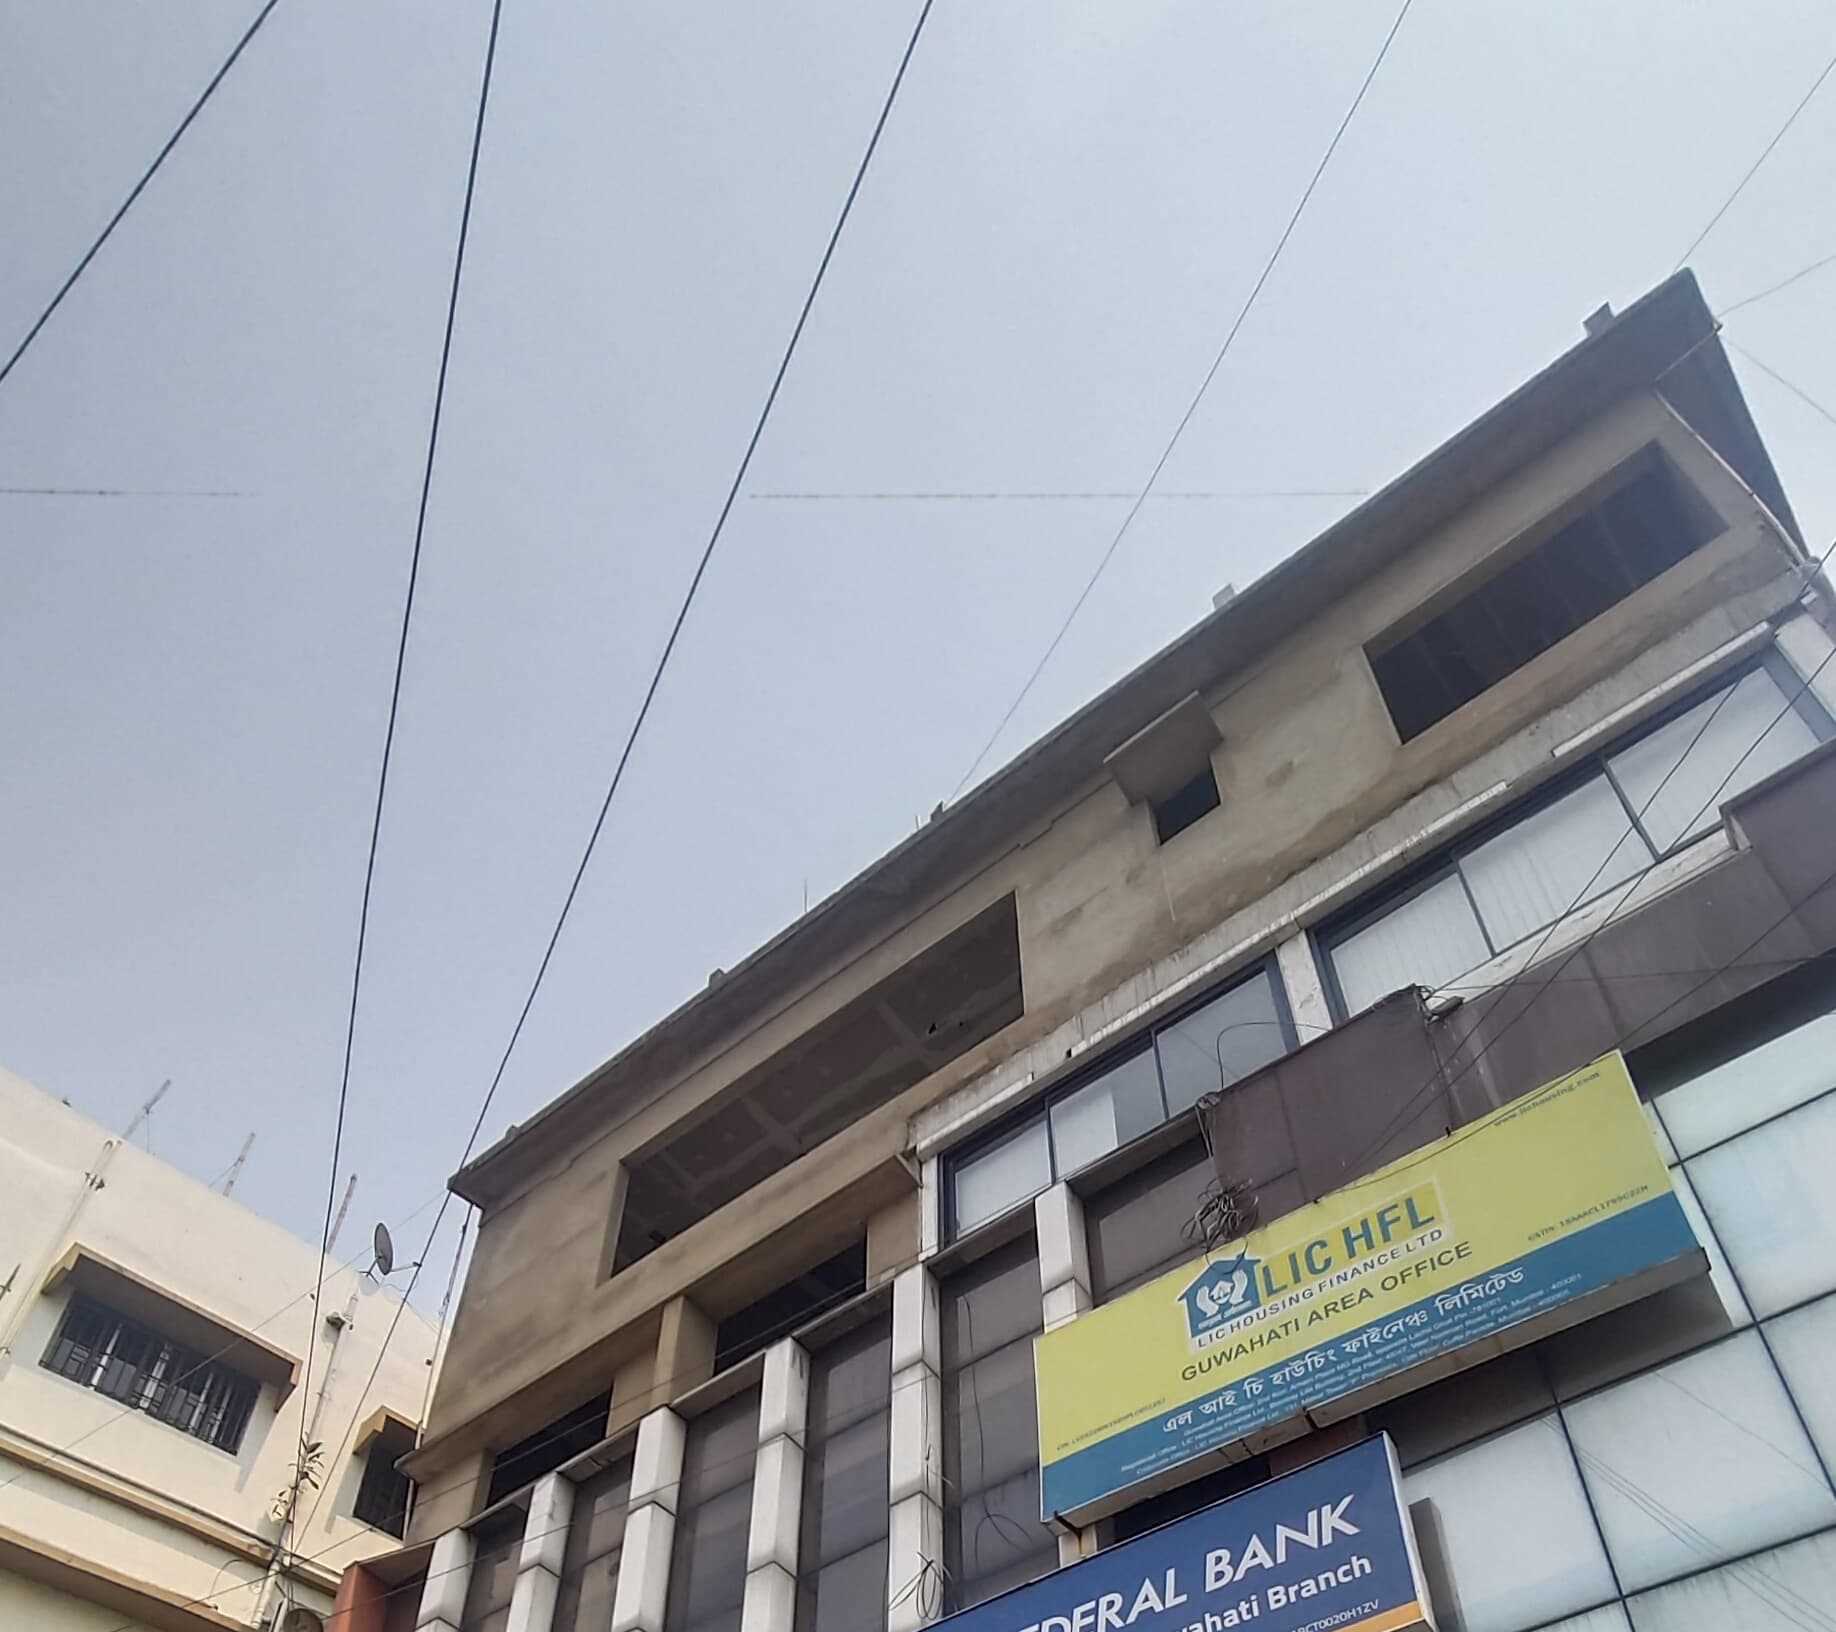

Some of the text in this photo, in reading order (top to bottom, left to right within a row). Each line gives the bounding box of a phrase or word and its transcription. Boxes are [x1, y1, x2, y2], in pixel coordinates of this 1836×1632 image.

[1198, 1328, 1226, 1348] LIC
[1230, 1288, 1314, 1333] HOUSING
[1317, 1247, 1401, 1293] FINANCE
[1406, 1228, 1443, 1253] LTD
[1262, 1196, 1436, 1298] LIC HFL
[1162, 1409, 1195, 1433] এল
[1198, 1389, 1238, 1415] আই
[1243, 1376, 1266, 1400] চি
[1269, 1347, 1338, 1386] হাউচিং
[1434, 1265, 1526, 1318] লিমিটেড
[1181, 1317, 1300, 1382] GUWAHATI
[1306, 1287, 1374, 1327] AREA
[1380, 1240, 1473, 1292] OFFICE
[1204, 1493, 1361, 1593] BANK
[1267, 1554, 1373, 1612] Branch
